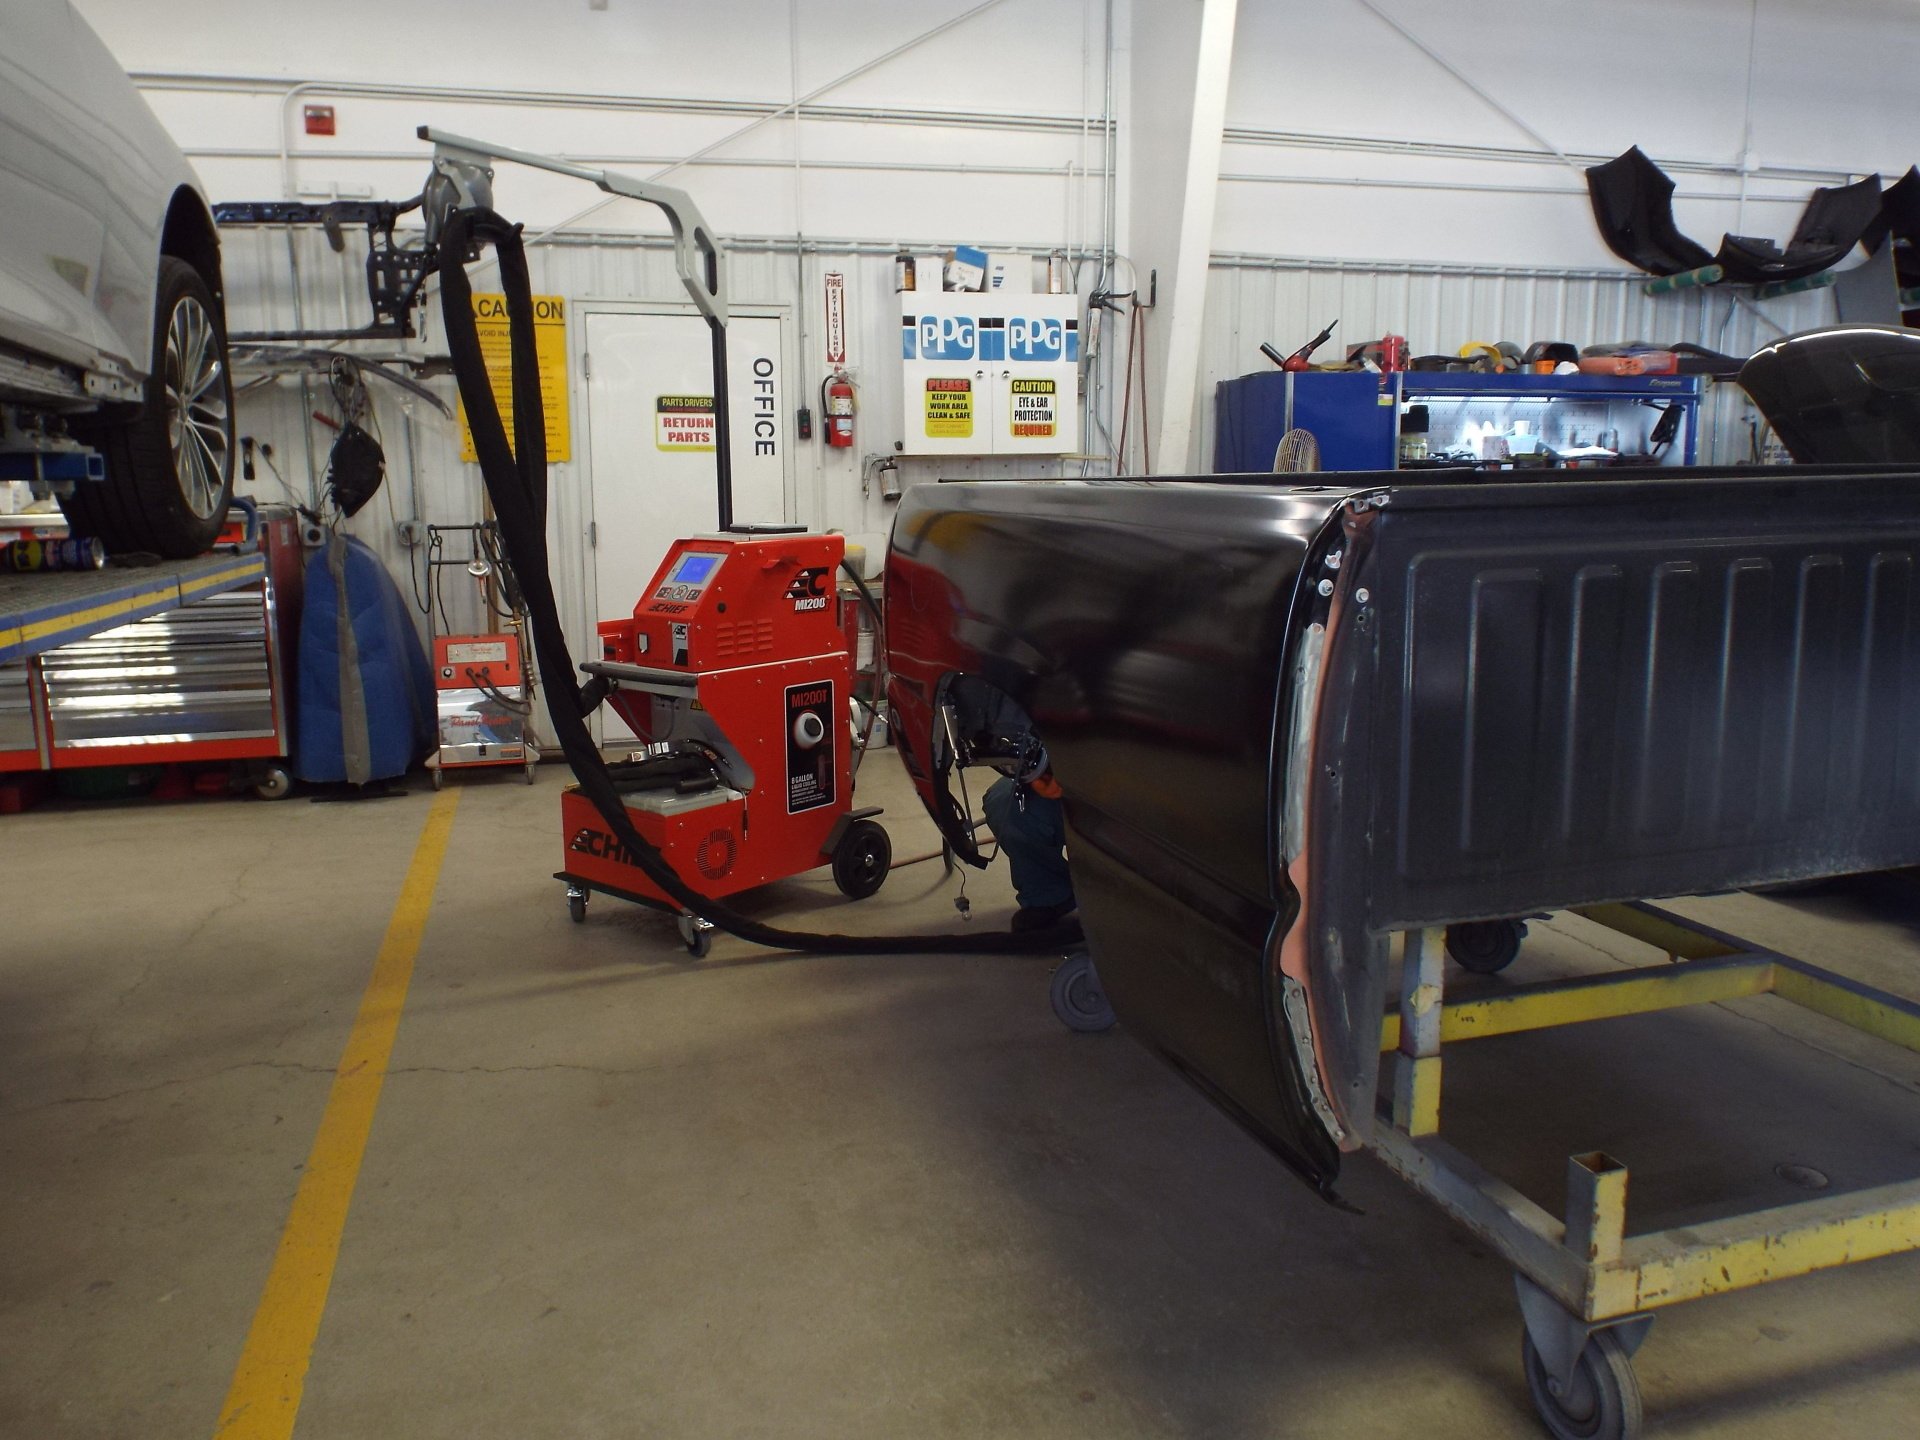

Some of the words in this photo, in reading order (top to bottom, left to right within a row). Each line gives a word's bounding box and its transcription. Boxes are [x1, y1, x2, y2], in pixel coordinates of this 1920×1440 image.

[826, 278, 842, 287] FIRE
[478, 299, 564, 319] CAON
[831, 288, 839, 357] EXTINGUISHER
[922, 315, 974, 353] PPG
[1010, 317, 1060, 355] PPG
[927, 379, 970, 391] PLEASE
[1013, 381, 1053, 393] CAUTION
[662, 398, 684, 407] PARTS
[684, 398, 713, 408] DRIVERS
[931, 393, 947, 401] KEEP
[949, 393, 967, 401] YOUR
[1018, 396, 1029, 408] EYE
[1030, 397, 1035, 408] &
[1036, 396, 1048, 408] EAR
[753, 357, 776, 456] OFFICE
[930, 402, 950, 410] WORK
[951, 402, 968, 410] AREA
[927, 411, 948, 419] CLEAN
[955, 411, 971, 419] SAFE
[1014, 410, 1053, 421] PROTECTION
[663, 417, 714, 428] RETURN
[1014, 424, 1052, 436] REQUIRED
[667, 432, 710, 442] PARTS
[791, 688, 828, 708] MI200T
